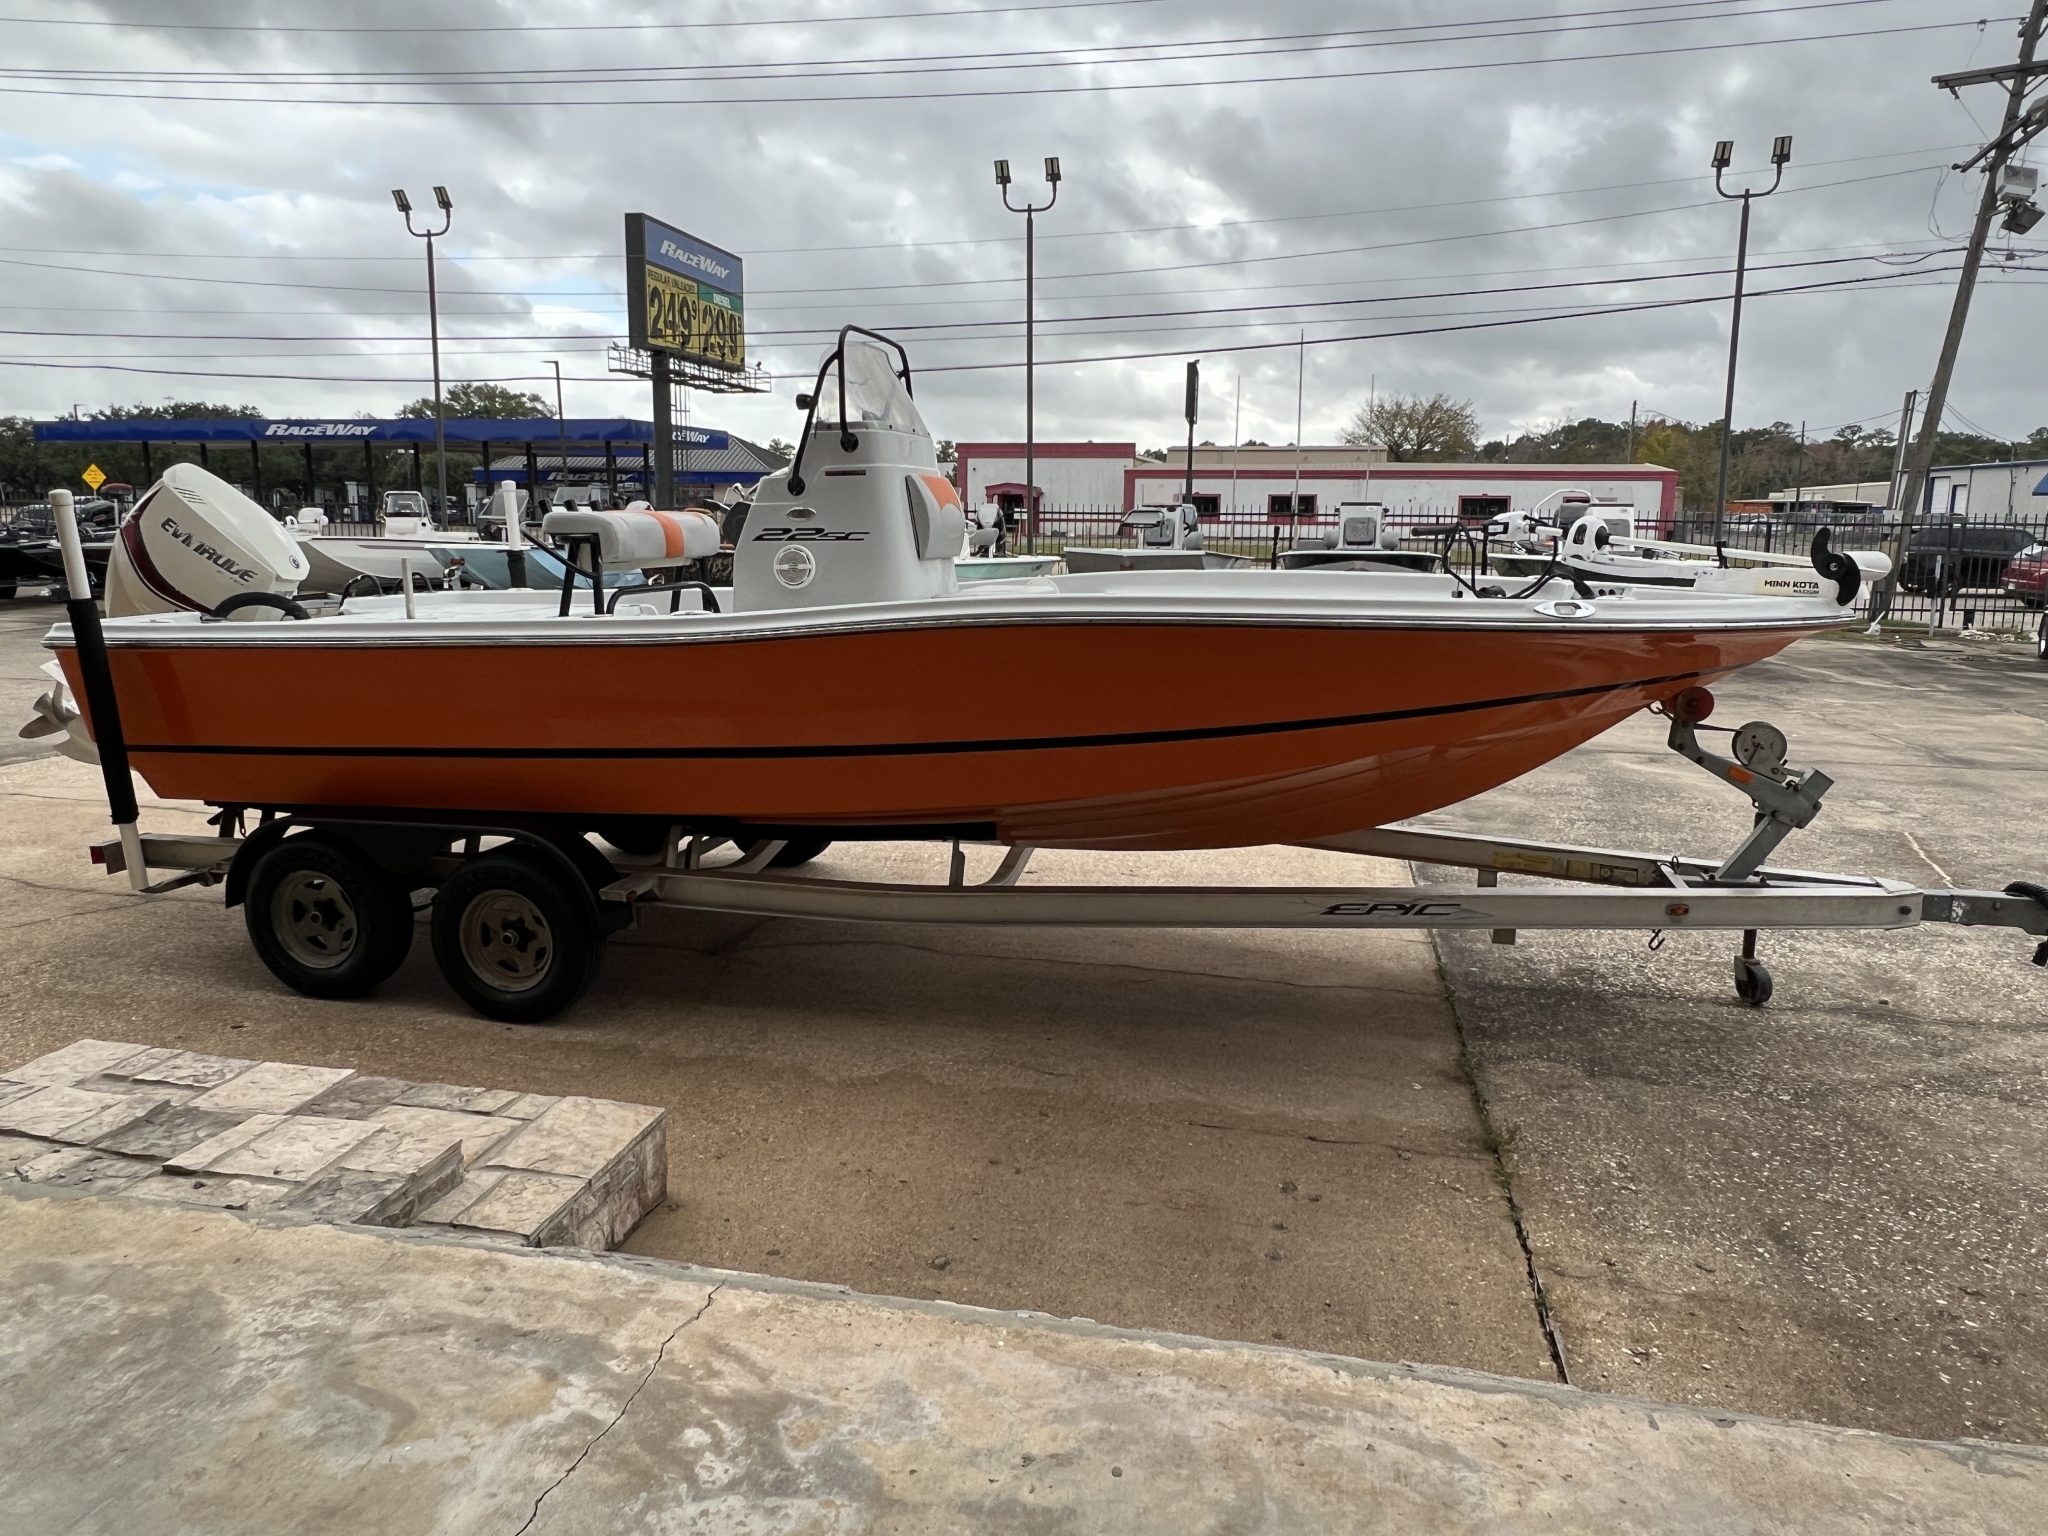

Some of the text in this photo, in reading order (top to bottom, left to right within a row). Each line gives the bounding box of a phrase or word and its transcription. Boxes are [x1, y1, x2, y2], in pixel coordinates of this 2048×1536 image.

[161, 517, 258, 583] EVINRUDE
[1764, 580, 1820, 589] MINN KOTA
[1320, 903, 1462, 915] EPIC
